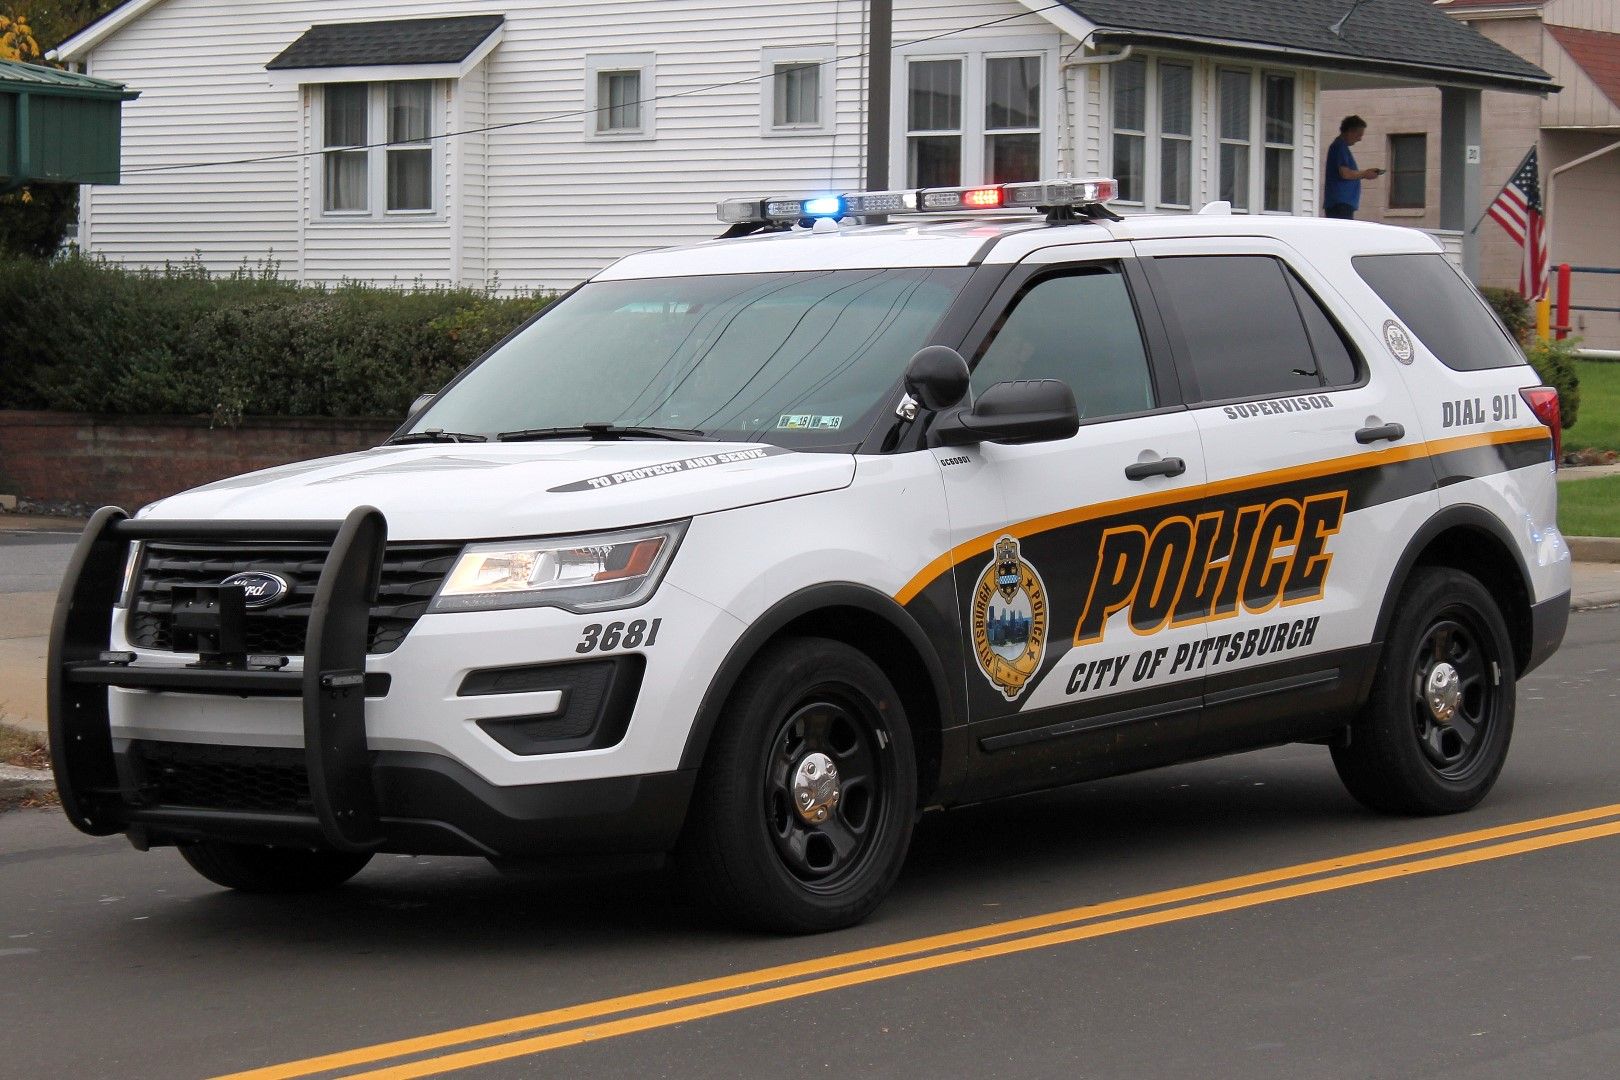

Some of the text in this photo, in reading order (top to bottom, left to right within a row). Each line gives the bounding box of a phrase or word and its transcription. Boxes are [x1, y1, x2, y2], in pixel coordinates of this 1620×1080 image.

[1223, 395, 1334, 420] SUPERVISOR
[1442, 394, 1518, 428] DIAL 911
[587, 449, 768, 489] TO PROTECT AND SERVE
[1072, 489, 1349, 648] POLICE
[575, 617, 662, 653] 3681
[975, 582, 992, 669] PITTSBURGH
[1031, 590, 1045, 647] POLICE
[1065, 616, 1320, 695] CITY OF PITTSBURGH
